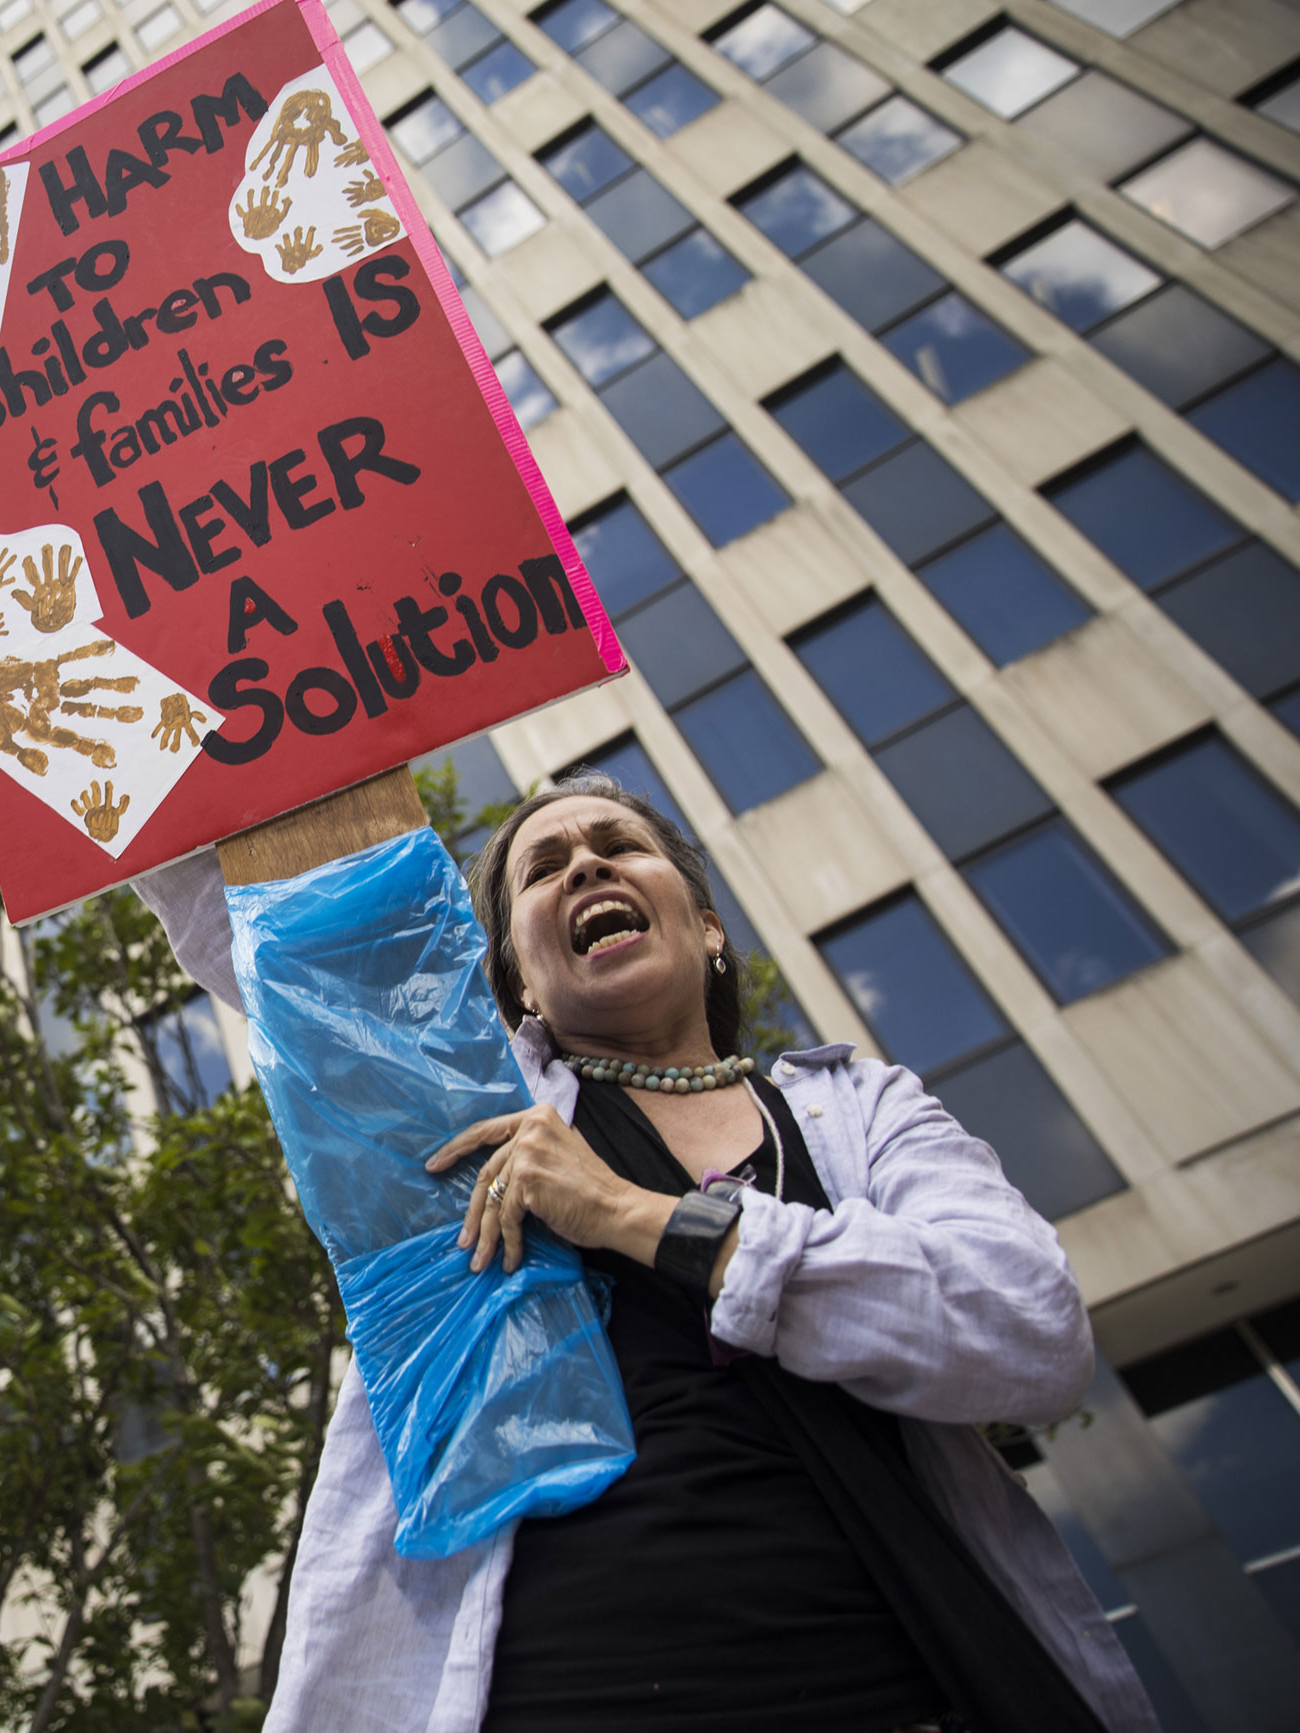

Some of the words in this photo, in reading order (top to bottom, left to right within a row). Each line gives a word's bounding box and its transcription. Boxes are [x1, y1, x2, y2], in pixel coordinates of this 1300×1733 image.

[38, 72, 270, 236] HARM
[27, 240, 130, 313] TO
[26, 425, 61, 512] &
[70, 339, 294, 487] families
[322, 254, 421, 361] IS
[92, 416, 421, 619] NEVER
[201, 554, 588, 766] Solution
[227, 575, 299, 654] A
